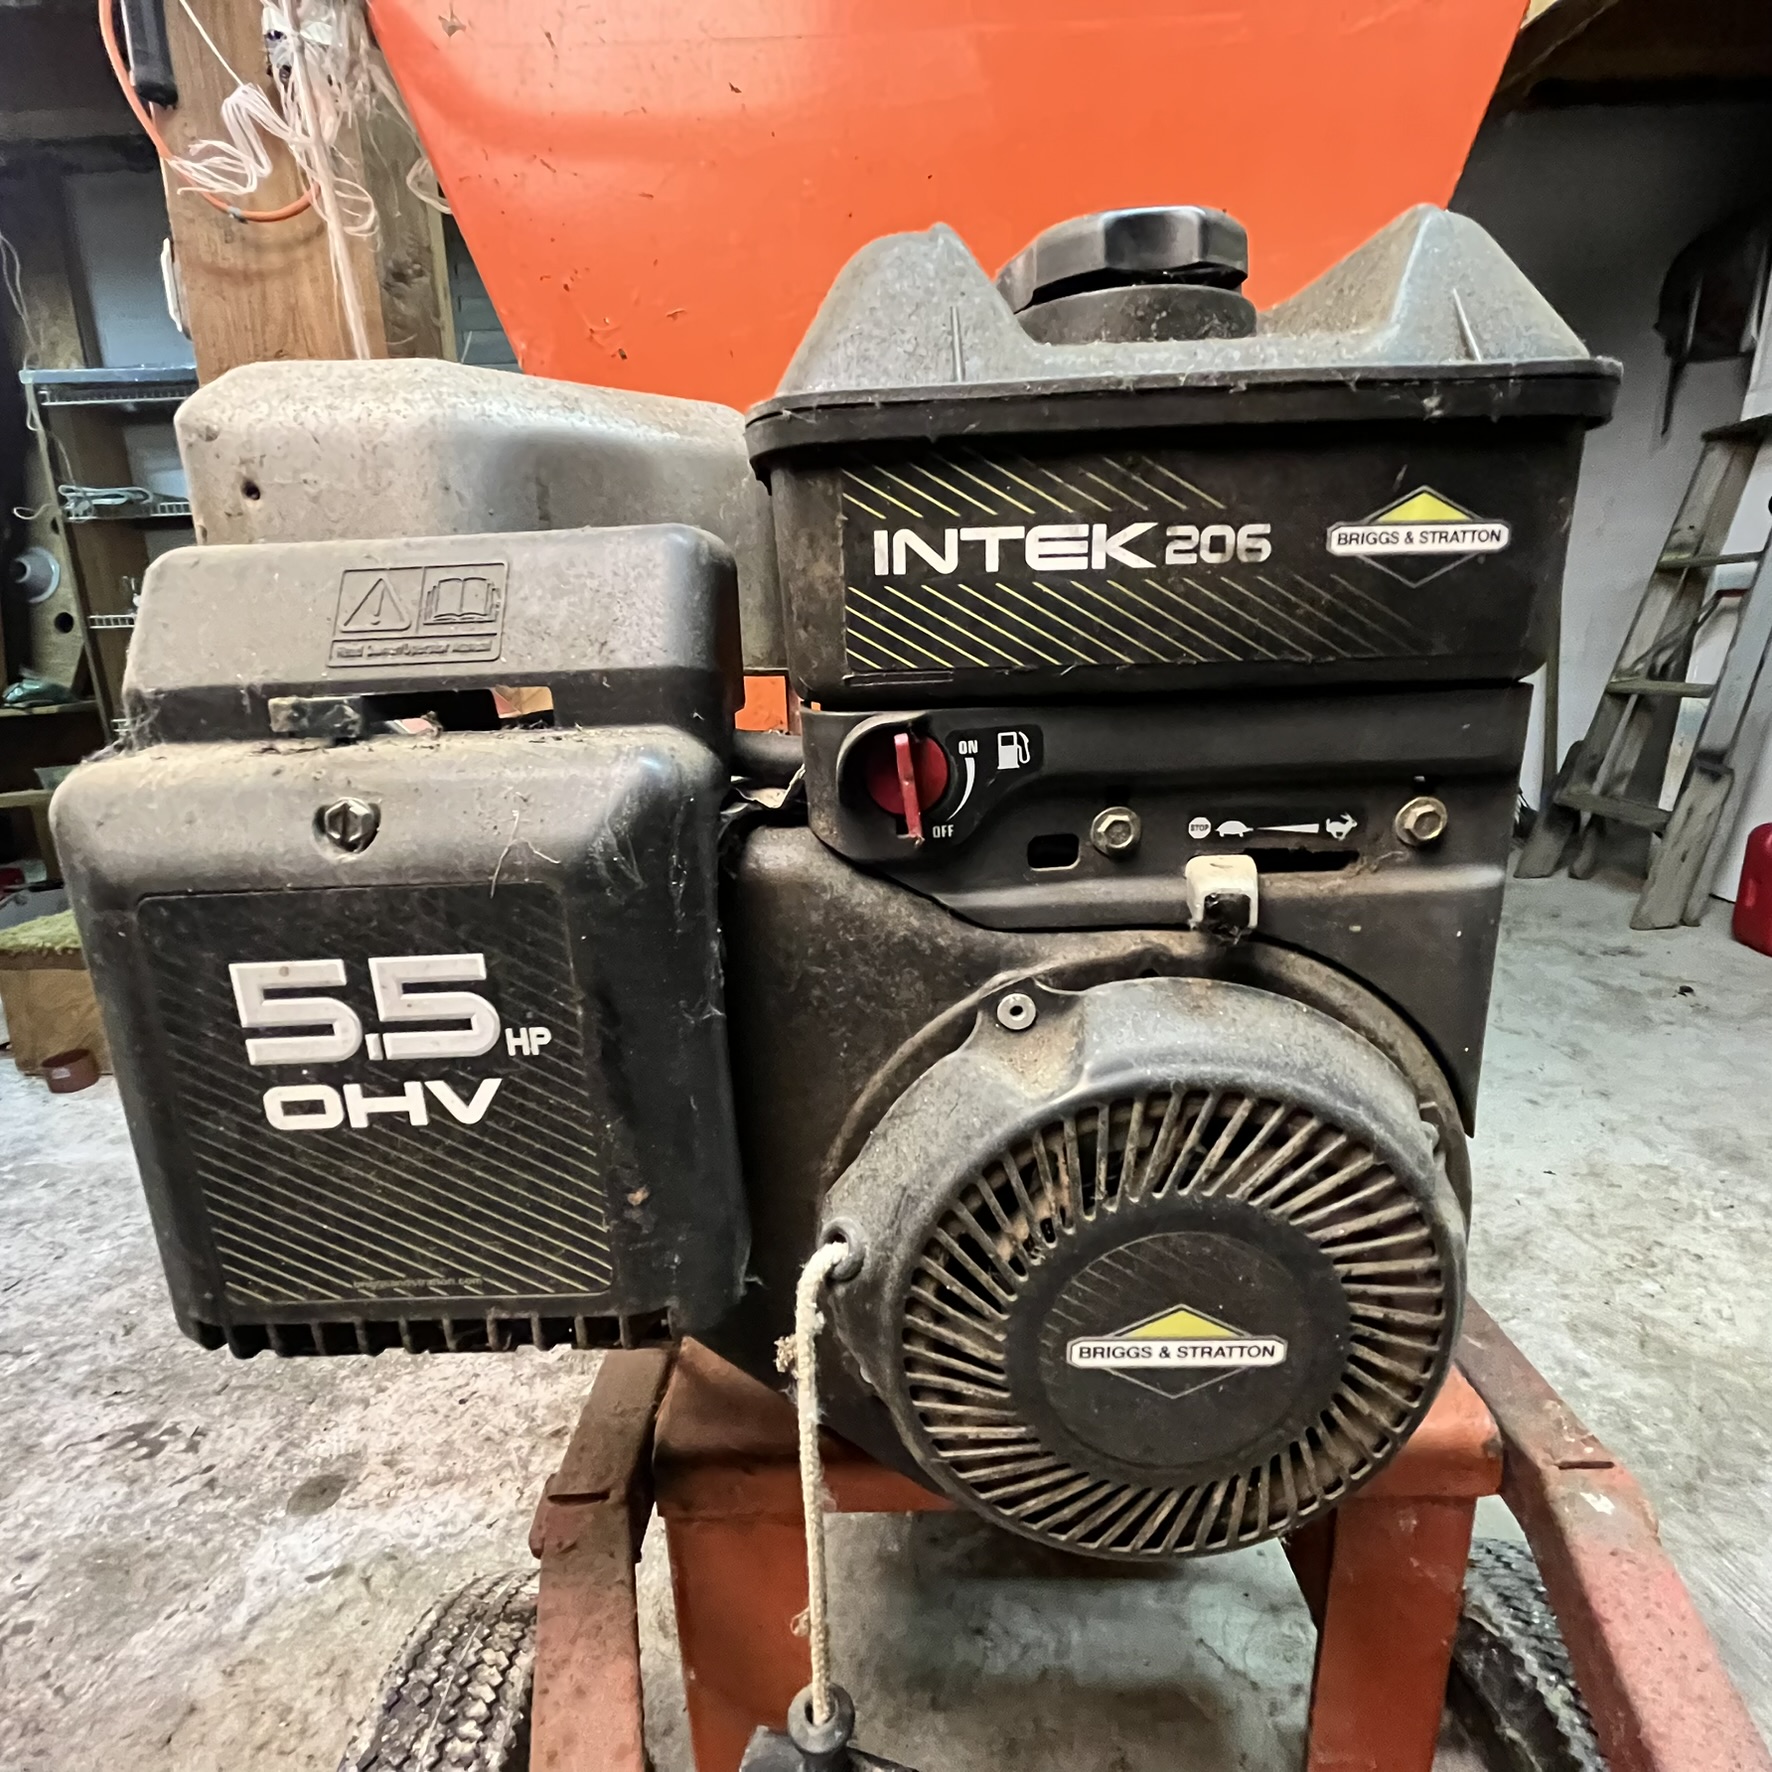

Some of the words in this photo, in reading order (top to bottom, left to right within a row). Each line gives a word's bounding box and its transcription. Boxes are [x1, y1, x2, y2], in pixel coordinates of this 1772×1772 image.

[1336, 531, 1400, 546] BRIGGS
[1404, 530, 1415, 545] &
[1418, 528, 1502, 545] STRATTON
[873, 521, 1159, 577] INTEK
[1164, 522, 1272, 566] 206
[958, 739, 979, 755] ON
[932, 824, 954, 839] OFF
[1189, 823, 1210, 832] STOP
[228, 952, 501, 1066] 5.5
[504, 1026, 552, 1057] HP
[262, 1077, 503, 1131] OHV
[1078, 1345, 1153, 1359] BRIGGS
[1158, 1345, 1172, 1359] &
[1176, 1345, 1276, 1359] STRATTON
